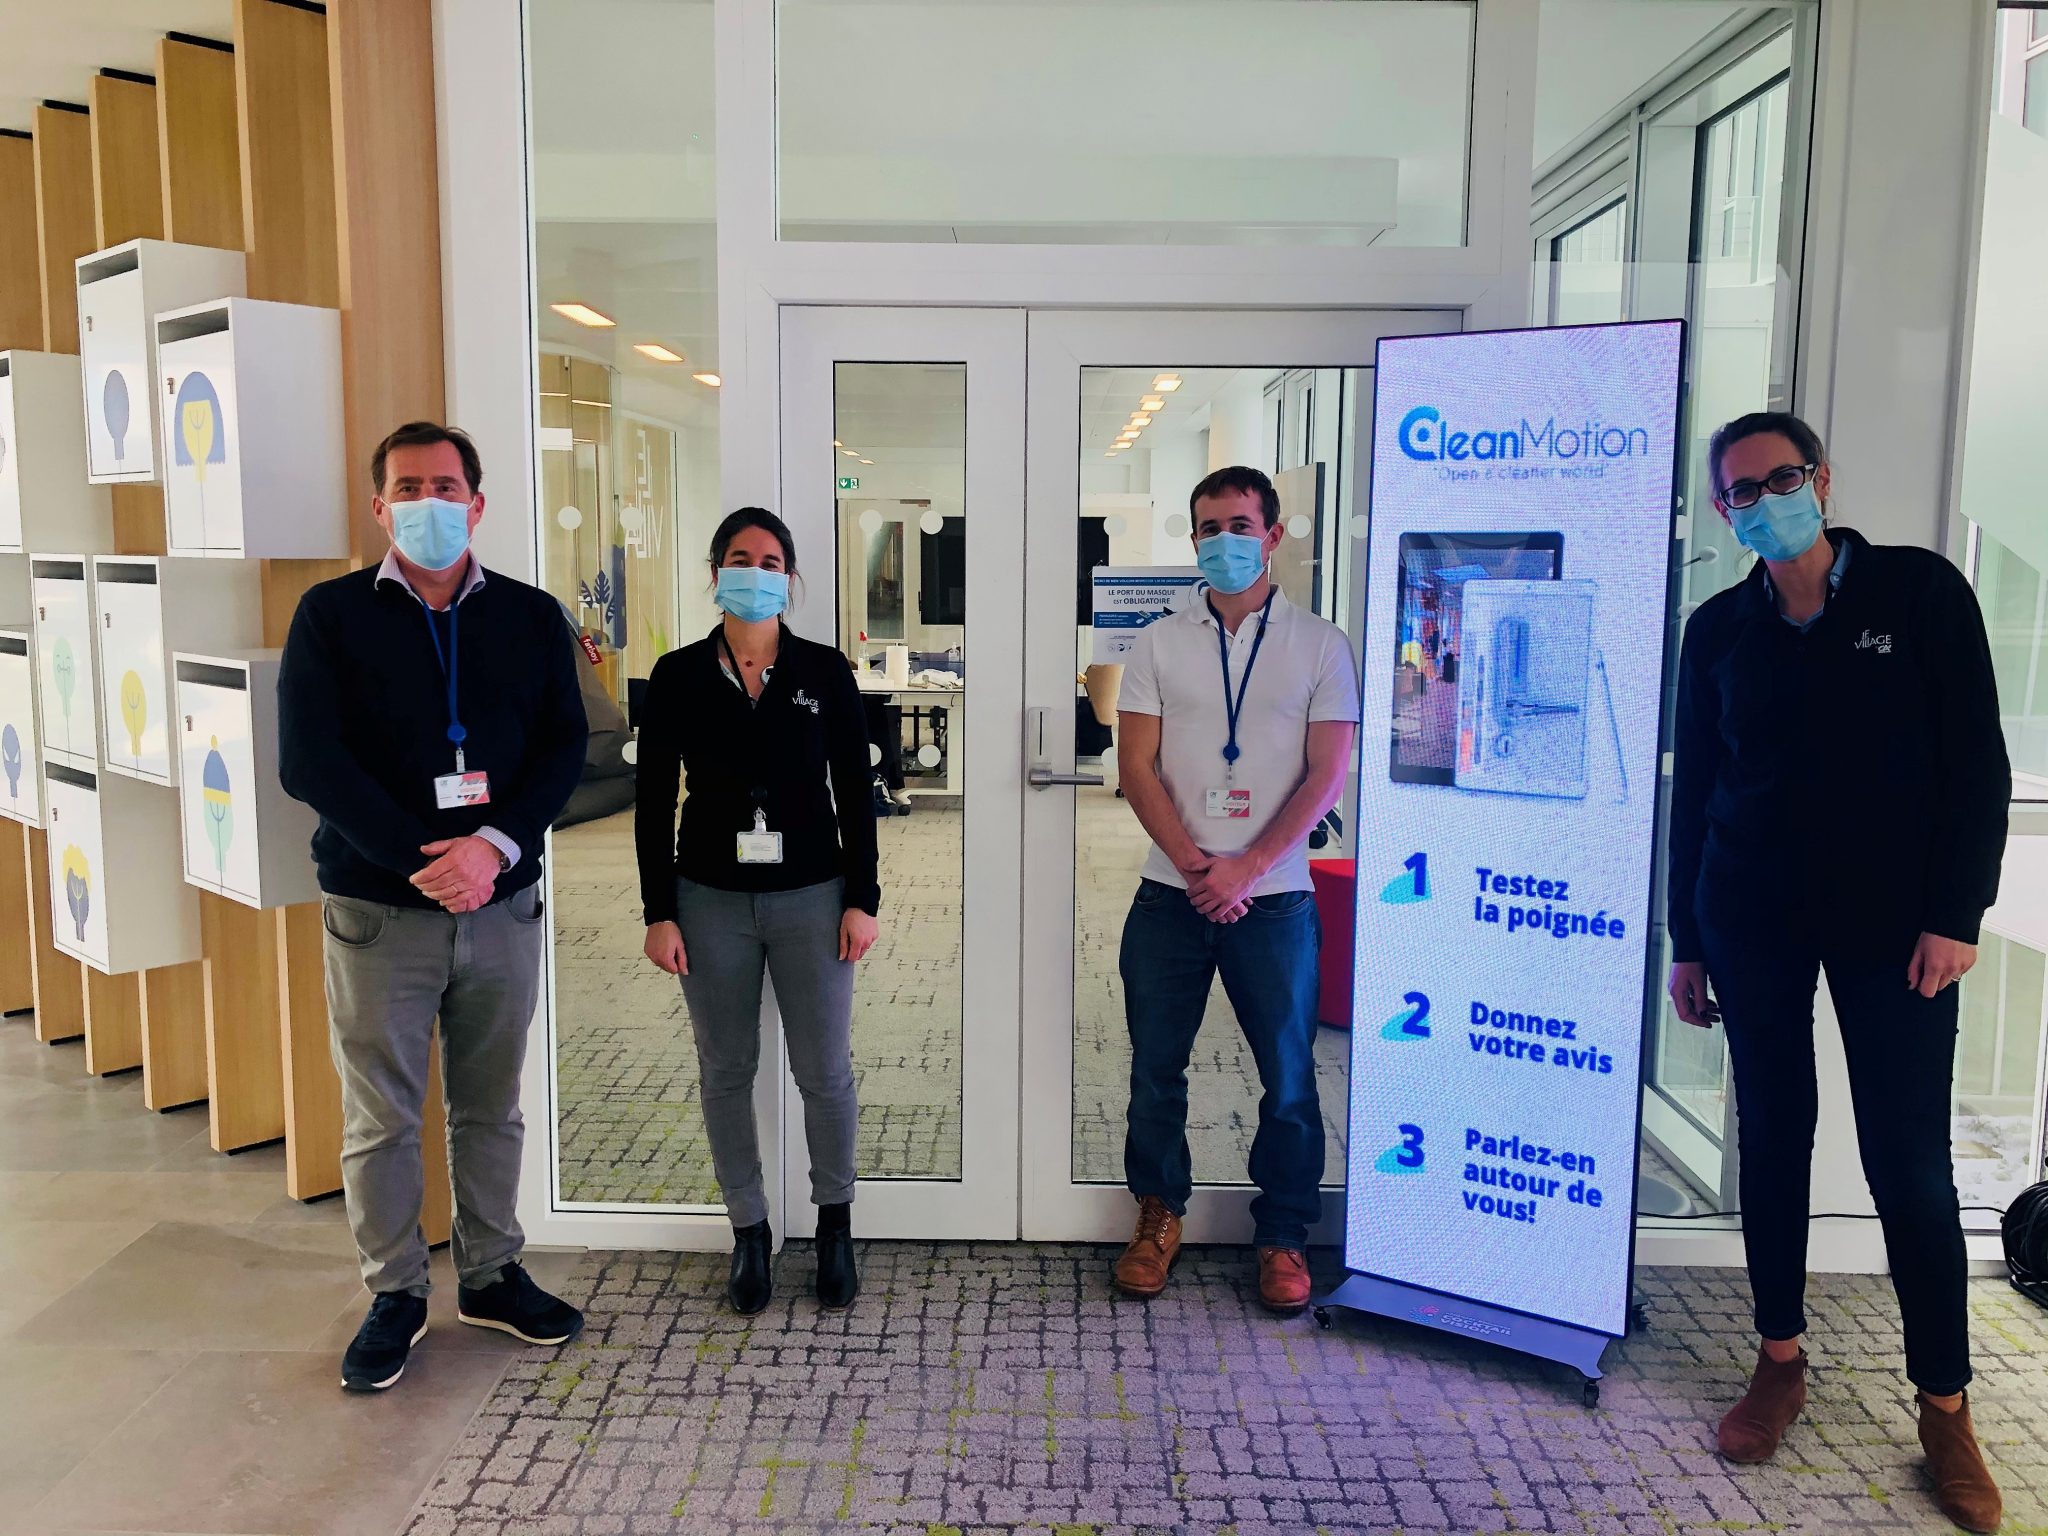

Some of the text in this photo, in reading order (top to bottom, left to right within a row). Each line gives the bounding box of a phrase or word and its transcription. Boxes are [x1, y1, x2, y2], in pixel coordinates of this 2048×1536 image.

[1398, 405, 1648, 461] CleanMotion
[1123, 597, 1171, 605] OBLIGATOIRE
[1147, 589, 1176, 597] MASQUE
[583, 638, 599, 662] fatboy
[1854, 634, 1892, 650] VILLAGE
[792, 696, 819, 708] VILLAGE
[1404, 852, 1428, 897] 1
[1475, 866, 1569, 902] Testez
[1474, 896, 1626, 939] la poignée
[1401, 991, 1431, 1038] 2
[1470, 1001, 1577, 1040] Donnez
[1468, 1032, 1614, 1074] votre avis
[1397, 1123, 1425, 1168] 3
[1464, 1127, 1597, 1175] Parlez-en
[1463, 1161, 1604, 1208] autour de
[1462, 1190, 1538, 1224] vous!
[1440, 1317, 1491, 1335] VISION
[1442, 1314, 1512, 1336] COCKTAIL
